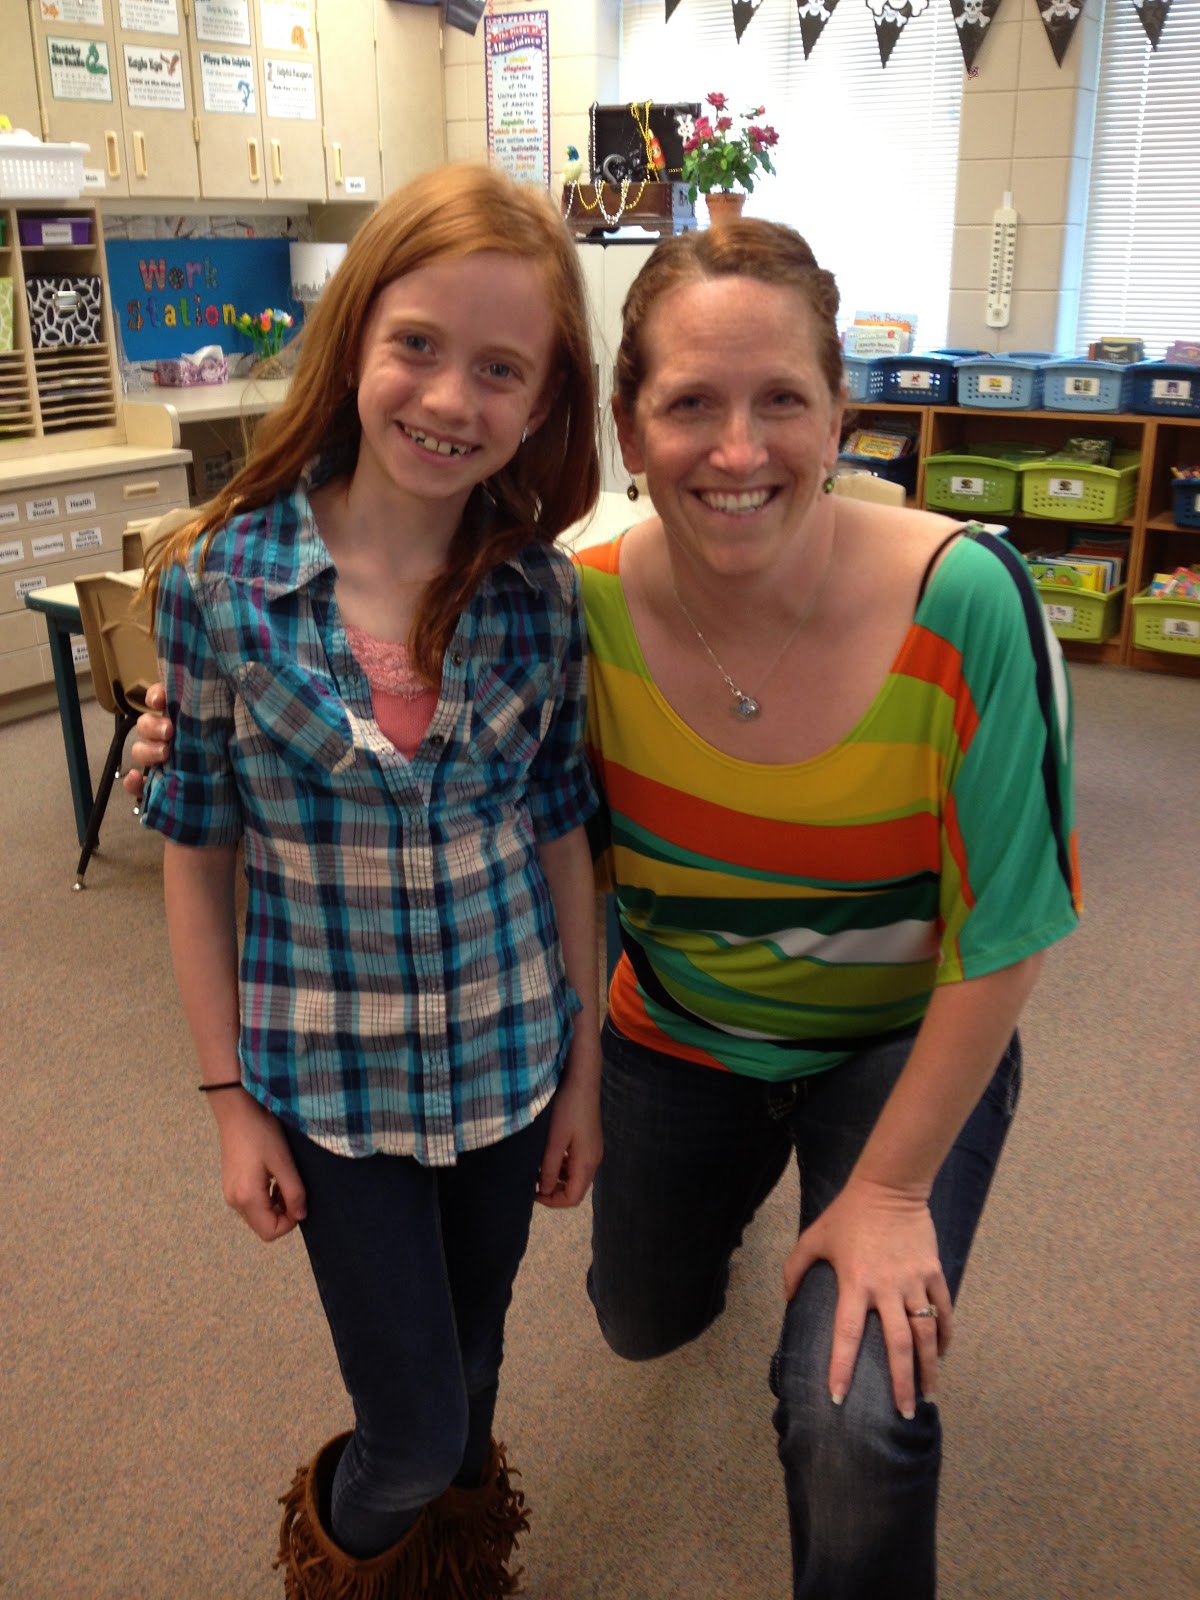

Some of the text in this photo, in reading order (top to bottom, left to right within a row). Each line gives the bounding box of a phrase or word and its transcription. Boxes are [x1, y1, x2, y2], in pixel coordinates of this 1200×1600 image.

[492, 36, 541, 53] Allegiance
[503, 65, 532, 73] allegiance
[138, 256, 218, 292] Work
[127, 293, 237, 332] Station
[33, 499, 52, 509] Social
[70, 497, 92, 508] Health
[32, 508, 56, 517] Studies
[19, 580, 42, 588] General
